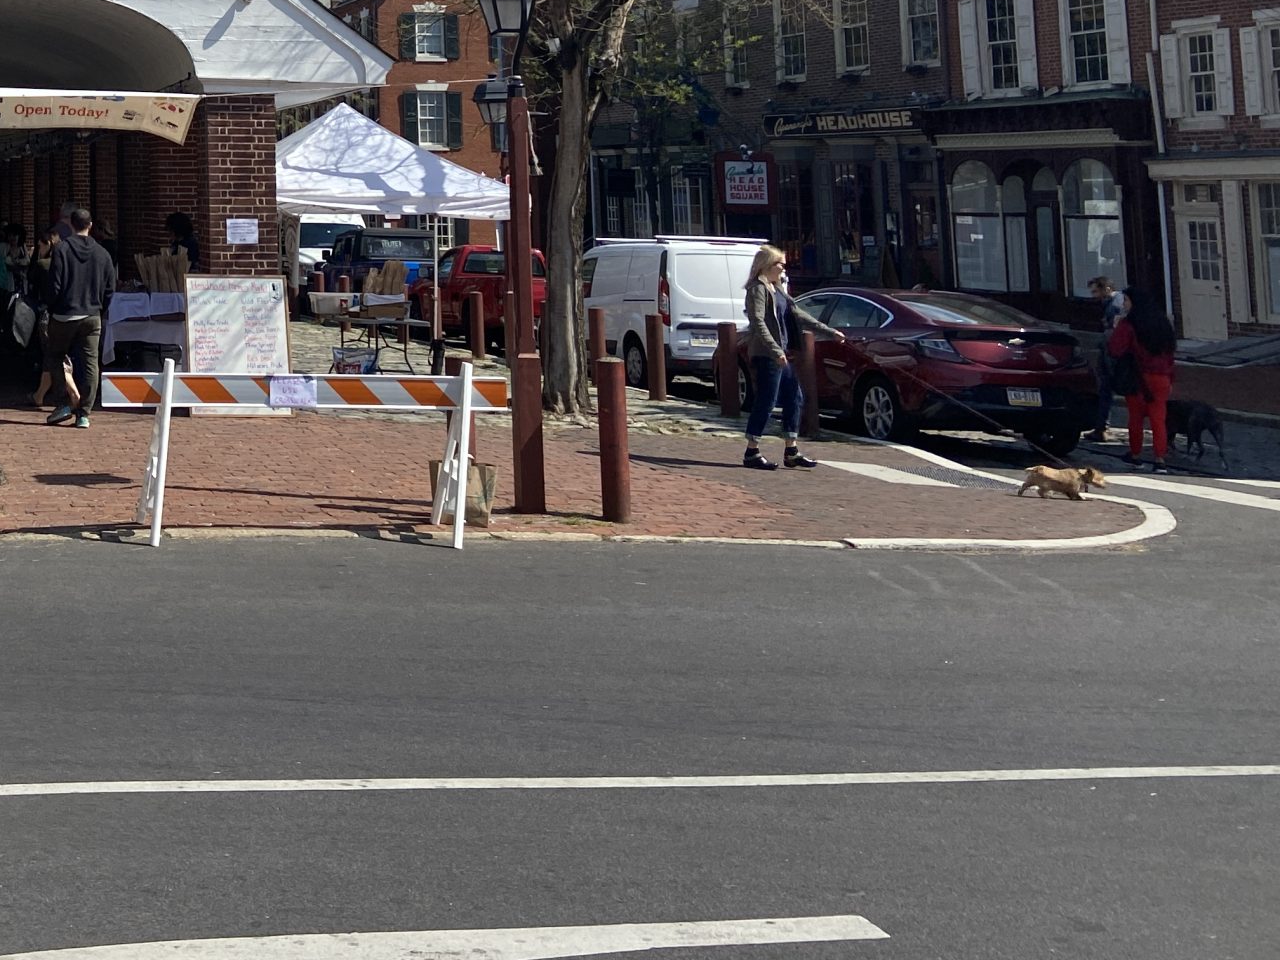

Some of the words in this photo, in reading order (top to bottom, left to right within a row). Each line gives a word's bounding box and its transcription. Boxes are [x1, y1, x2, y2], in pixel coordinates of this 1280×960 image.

[14, 104, 52, 118] Open
[58, 105, 109, 119] Today!
[816, 111, 913, 131] HEADHOUSE
[729, 176, 765, 184] HEAD
[730, 184, 765, 192] HOUSE
[730, 192, 765, 200] SQUARE
